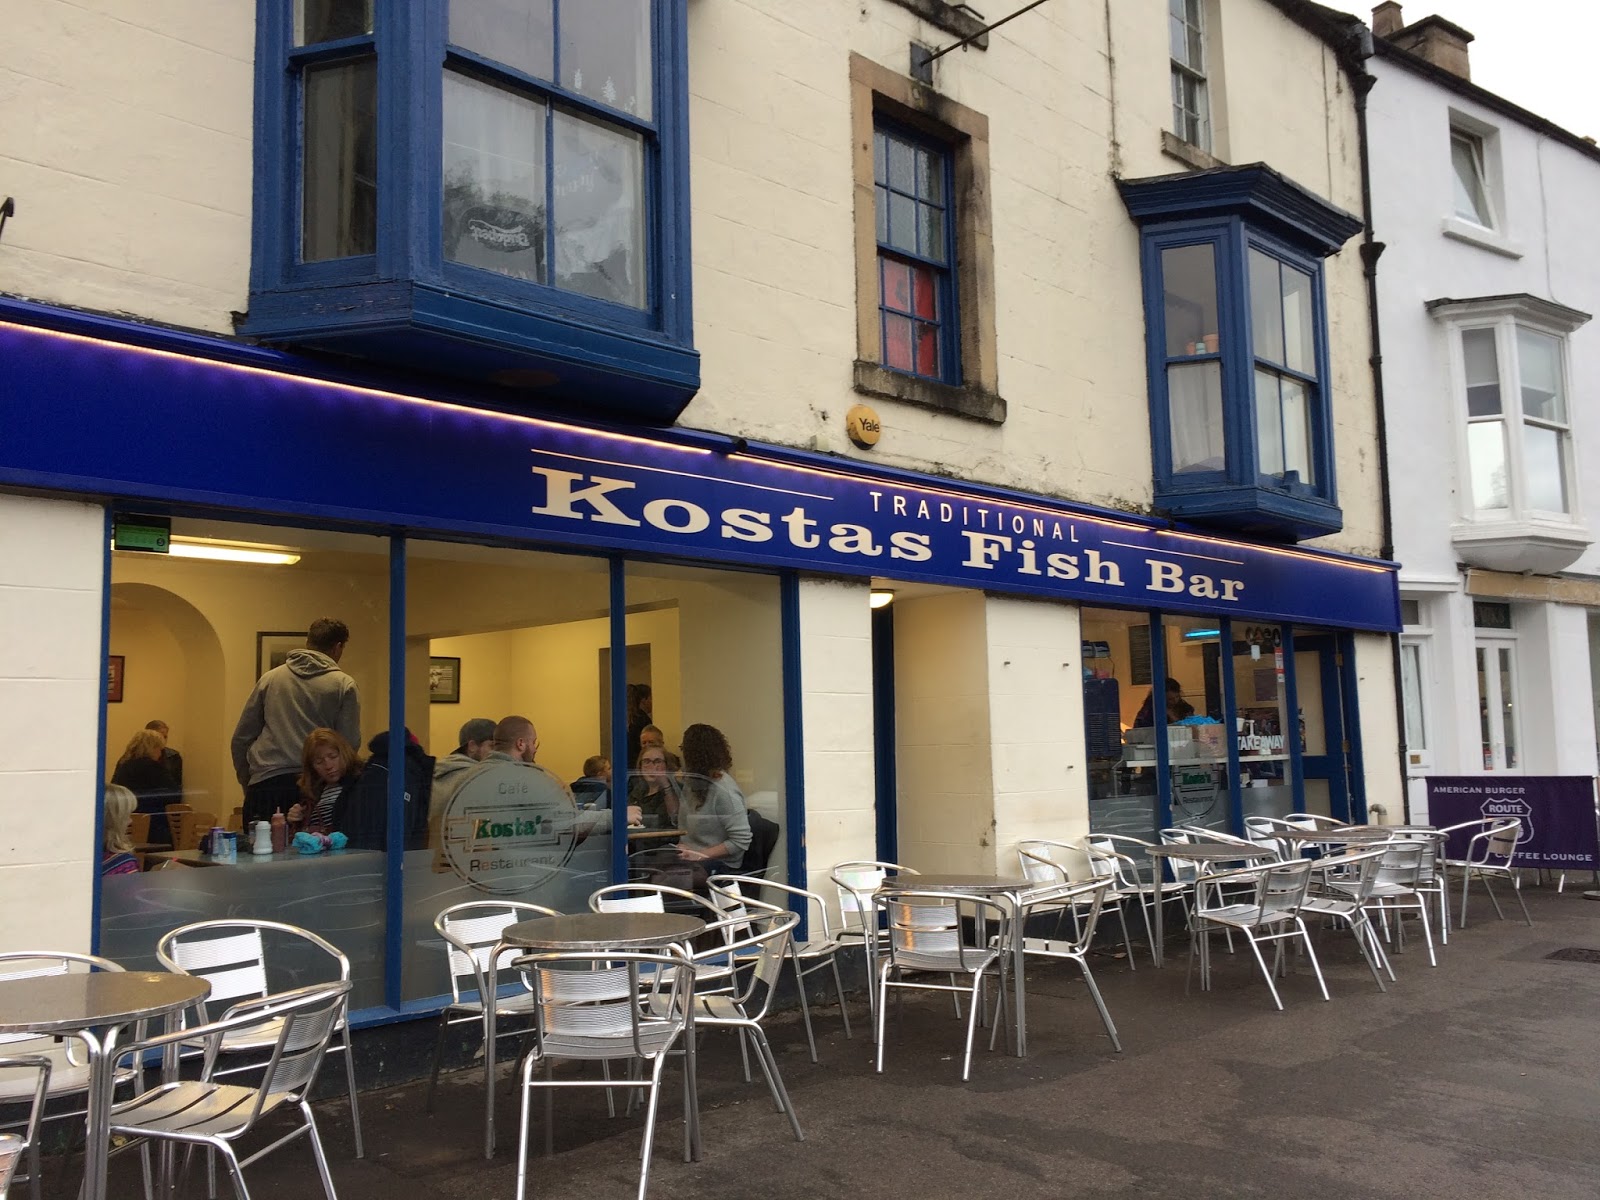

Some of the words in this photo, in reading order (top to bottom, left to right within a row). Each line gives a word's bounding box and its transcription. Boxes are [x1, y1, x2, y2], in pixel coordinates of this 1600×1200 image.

[859, 417, 880, 433] Yale
[869, 491, 1079, 543] TRADITIONAL
[531, 466, 932, 562] Kostas
[961, 530, 1125, 587] Fish
[1145, 558, 1245, 602] Bar
[1237, 734, 1285, 751] TAKEAWAY
[1433, 786, 1482, 794] AMERICAN
[1485, 787, 1526, 795] BURGER
[1489, 804, 1523, 813] ROUTE
[472, 815, 553, 840] Kosta's
[470, 855, 555, 872] Restaurant
[1543, 853, 1593, 862] LOUNGE
